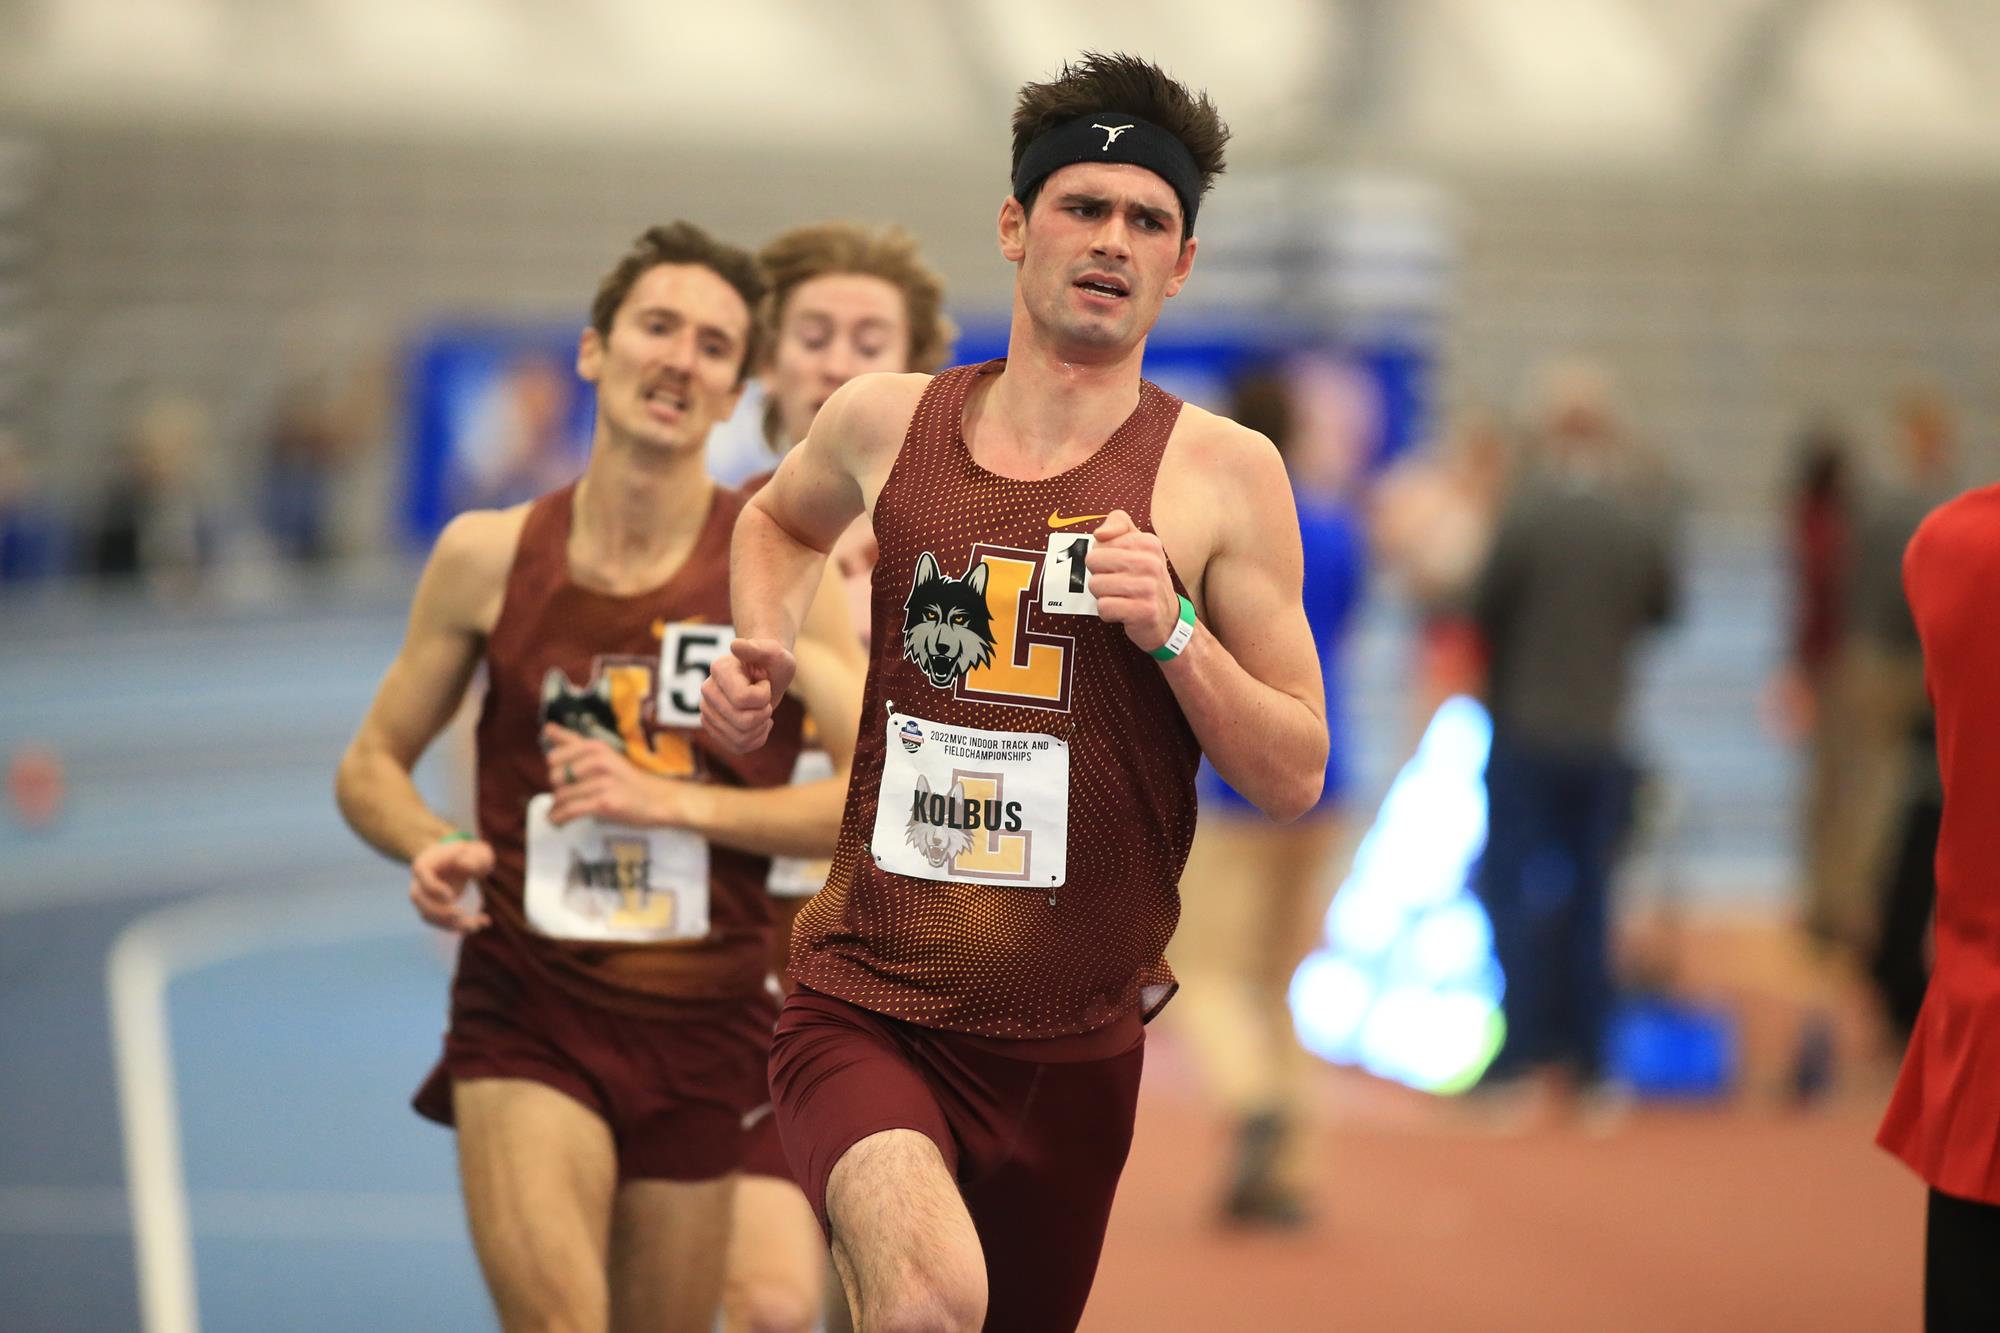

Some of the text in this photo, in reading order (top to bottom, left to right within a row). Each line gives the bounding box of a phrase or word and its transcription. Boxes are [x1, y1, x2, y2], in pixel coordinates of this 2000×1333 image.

[1056, 538, 1089, 593] 1
[954, 543, 1076, 713] L
[670, 635, 718, 716] 5
[969, 735, 998, 749] INDOOR
[1001, 740, 1028, 750] TRACK
[1031, 741, 1049, 751] AND
[913, 789, 1022, 832] KOLBUS
